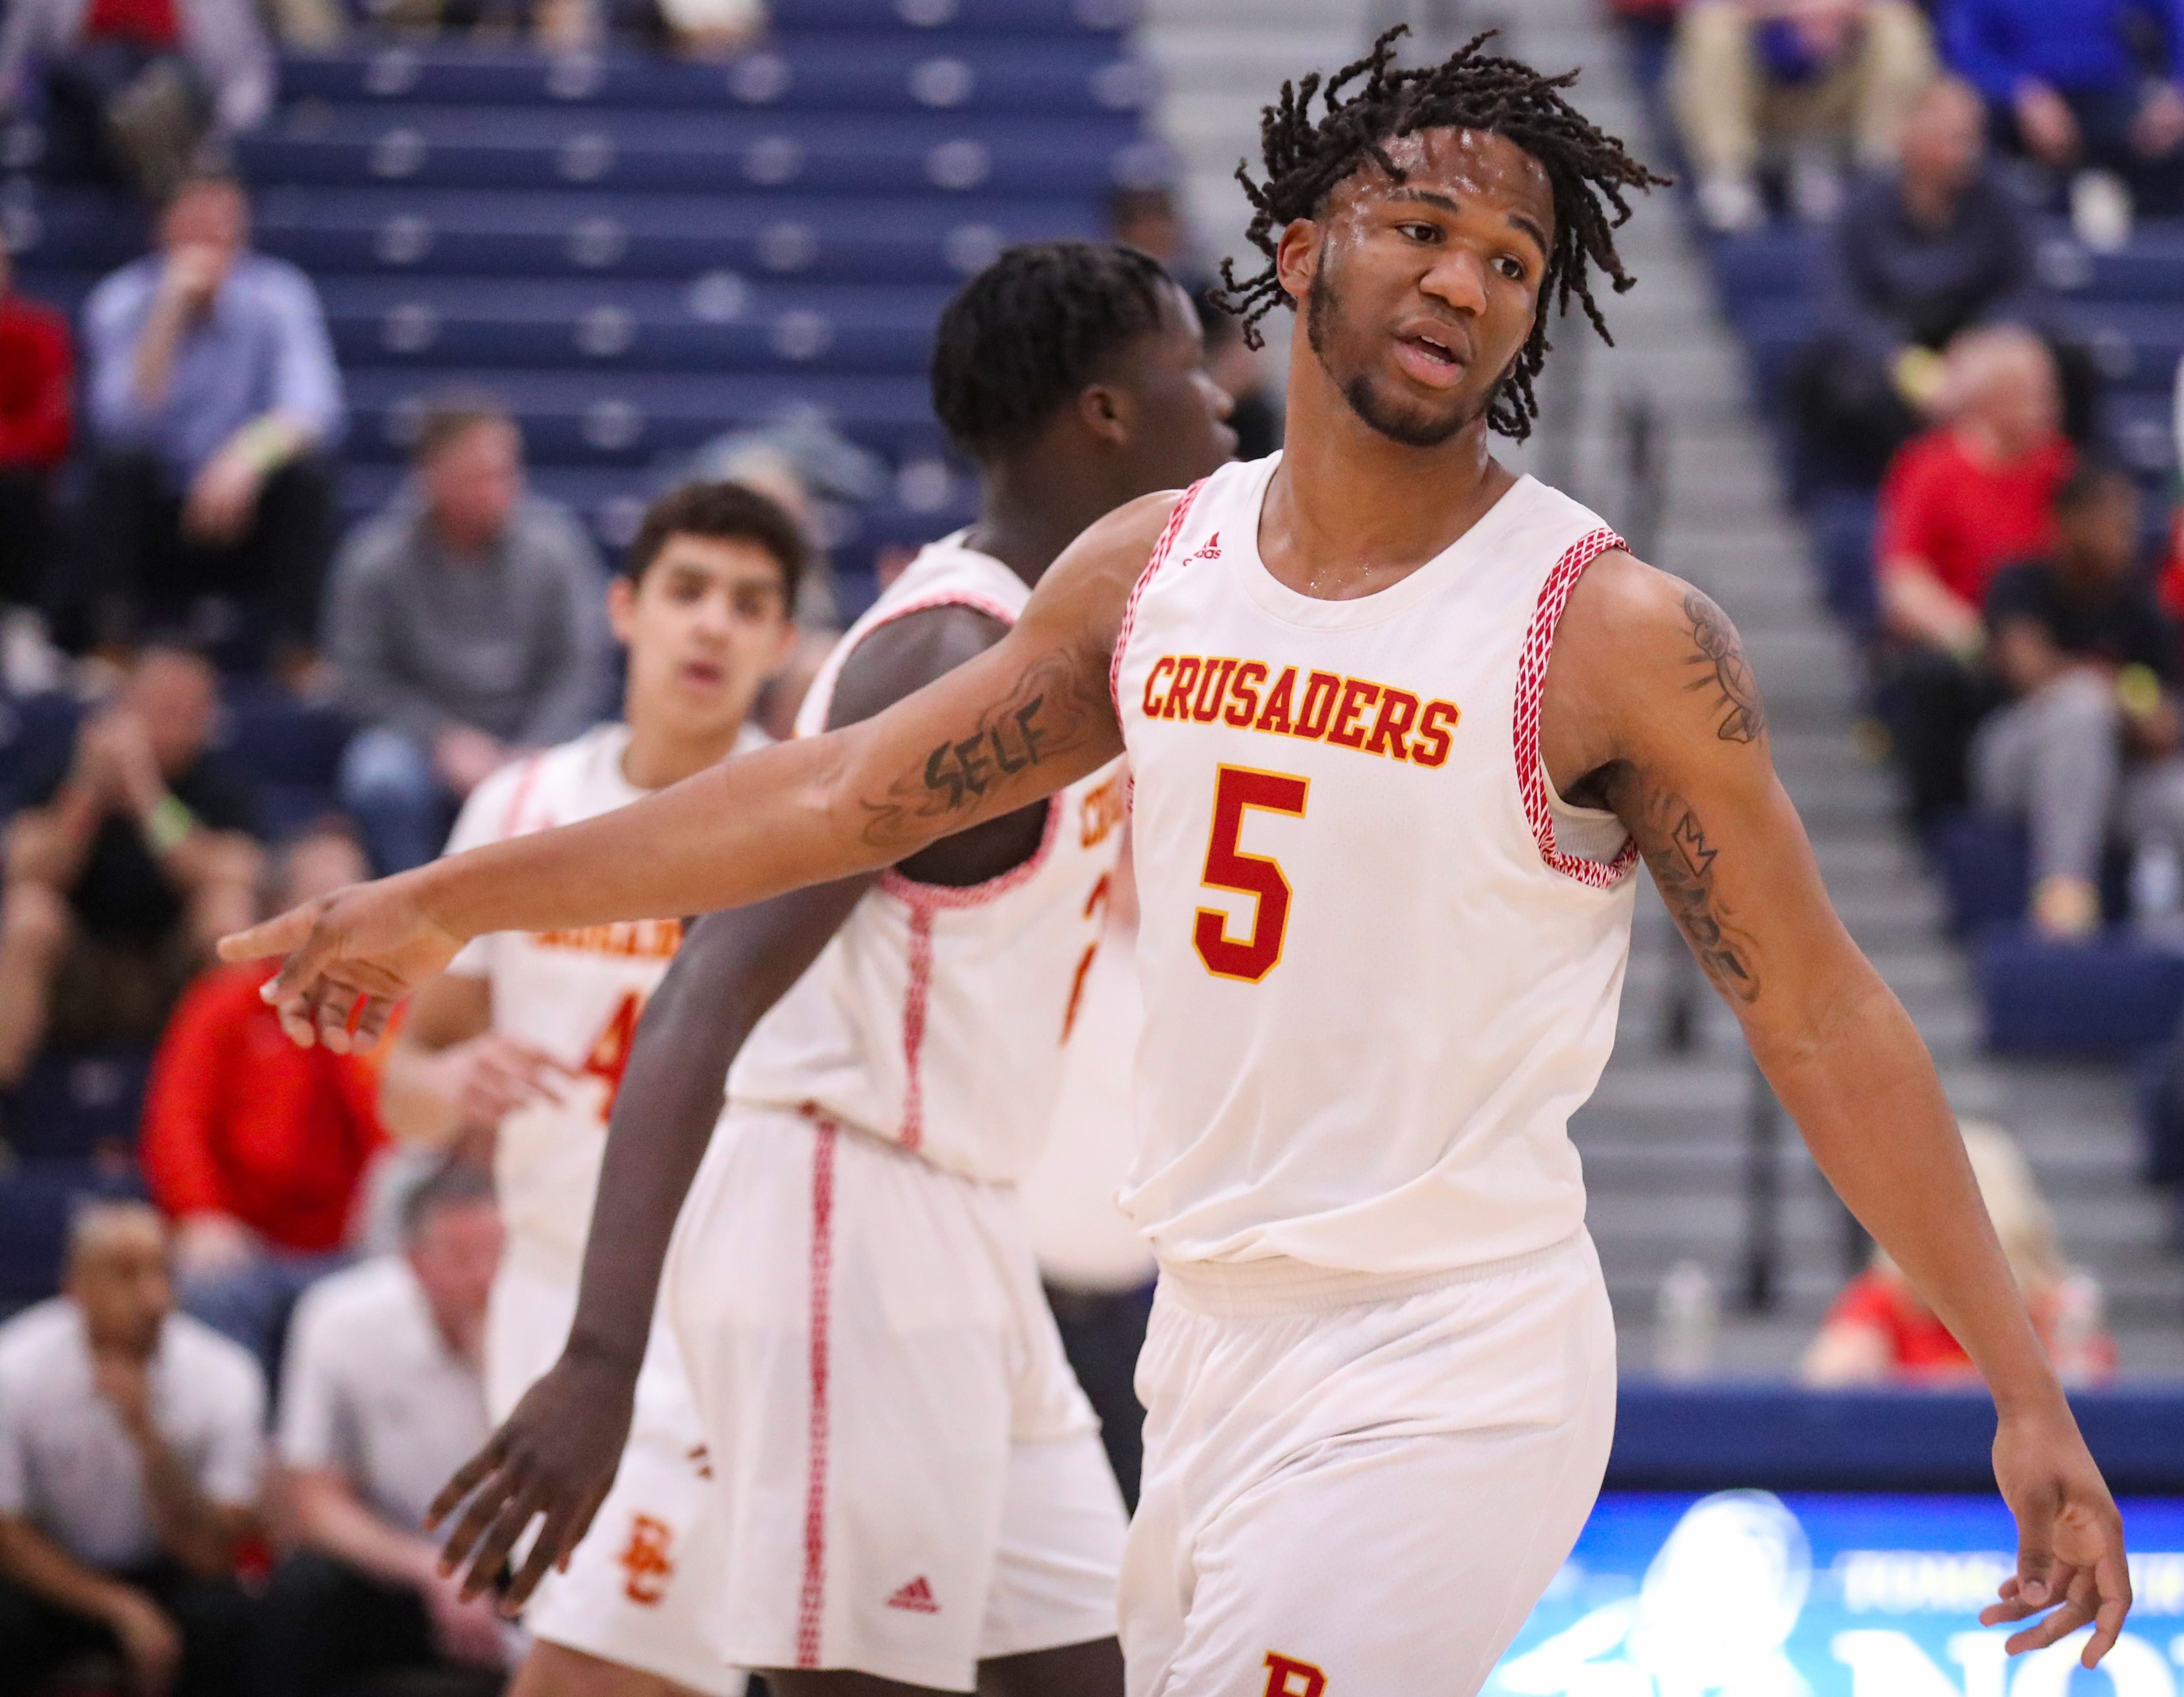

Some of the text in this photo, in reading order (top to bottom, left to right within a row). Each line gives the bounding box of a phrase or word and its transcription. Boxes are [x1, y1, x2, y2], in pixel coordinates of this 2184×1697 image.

[924, 693, 1045, 807] SELF
[1141, 654, 1461, 769] CRUSADERS
[1191, 762, 1311, 984] 5
